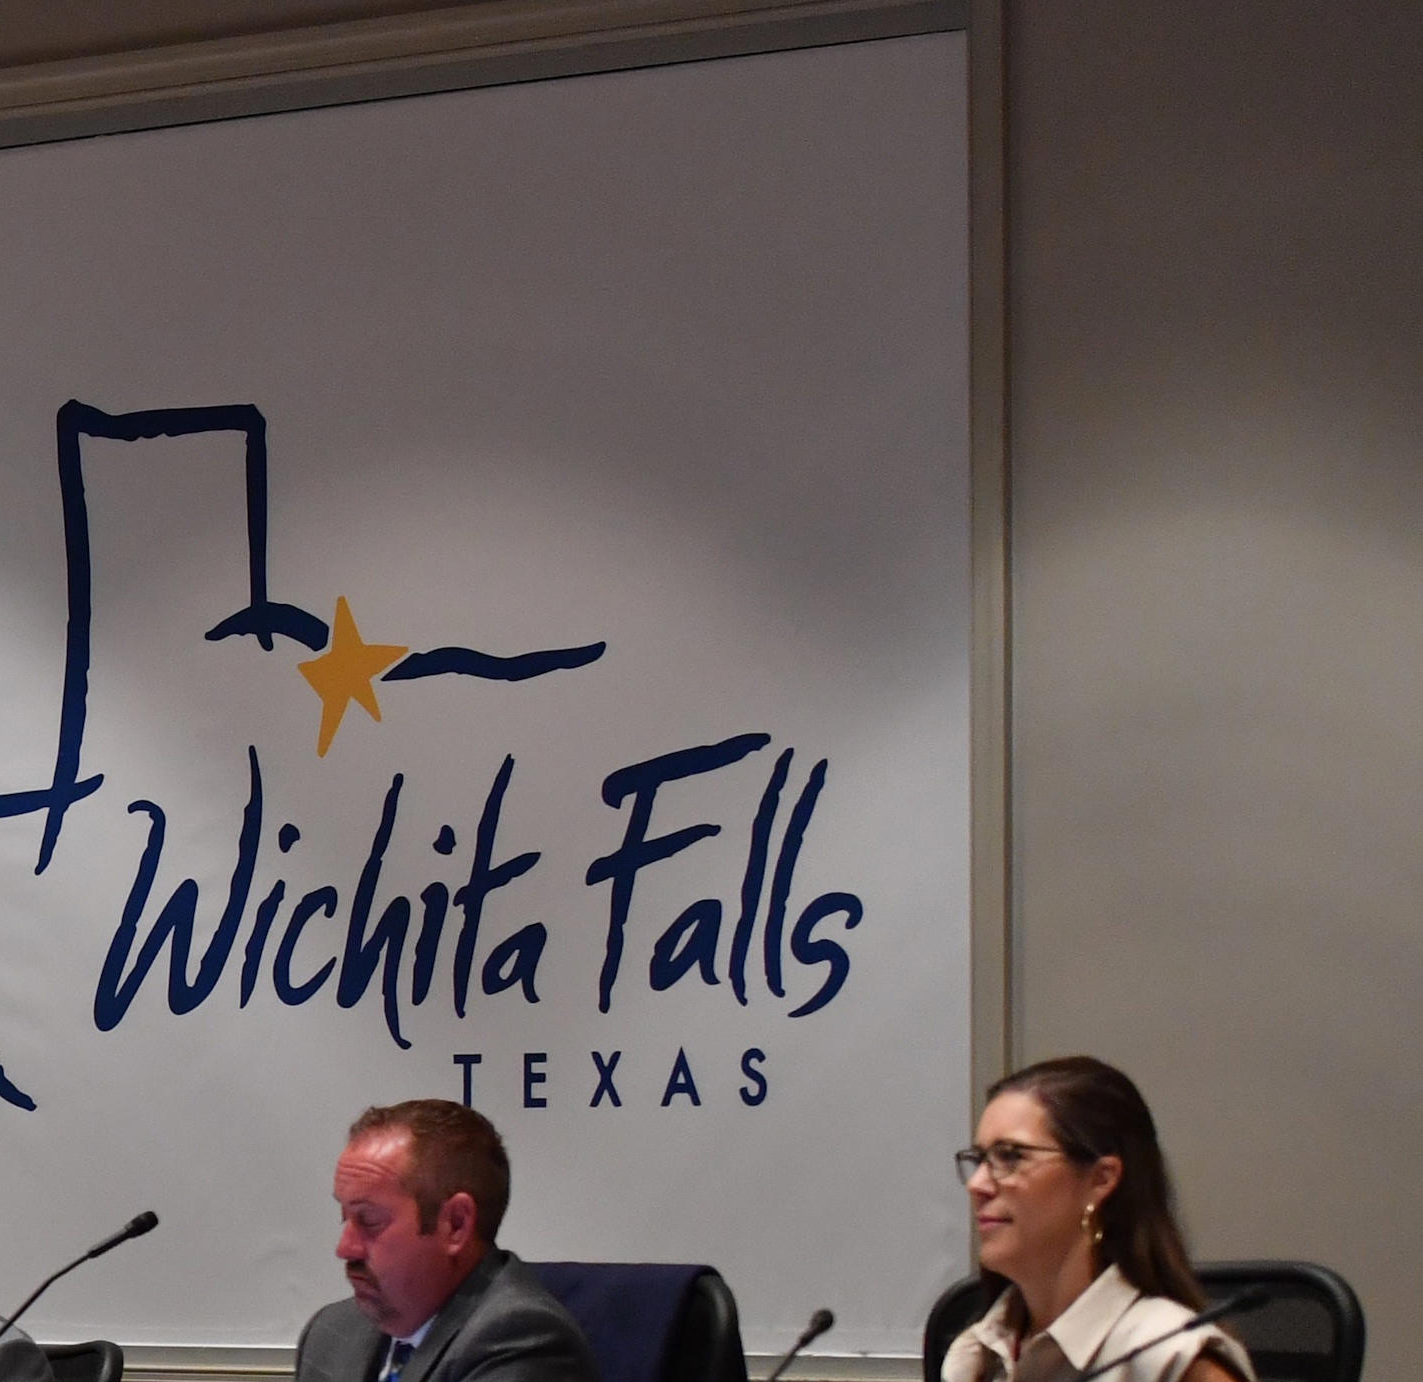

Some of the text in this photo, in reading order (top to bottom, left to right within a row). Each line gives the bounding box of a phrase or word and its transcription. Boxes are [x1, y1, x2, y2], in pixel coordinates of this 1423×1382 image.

[93, 733, 864, 1049] Wichita Falls
[452, 1047, 768, 1108] TEXAS
